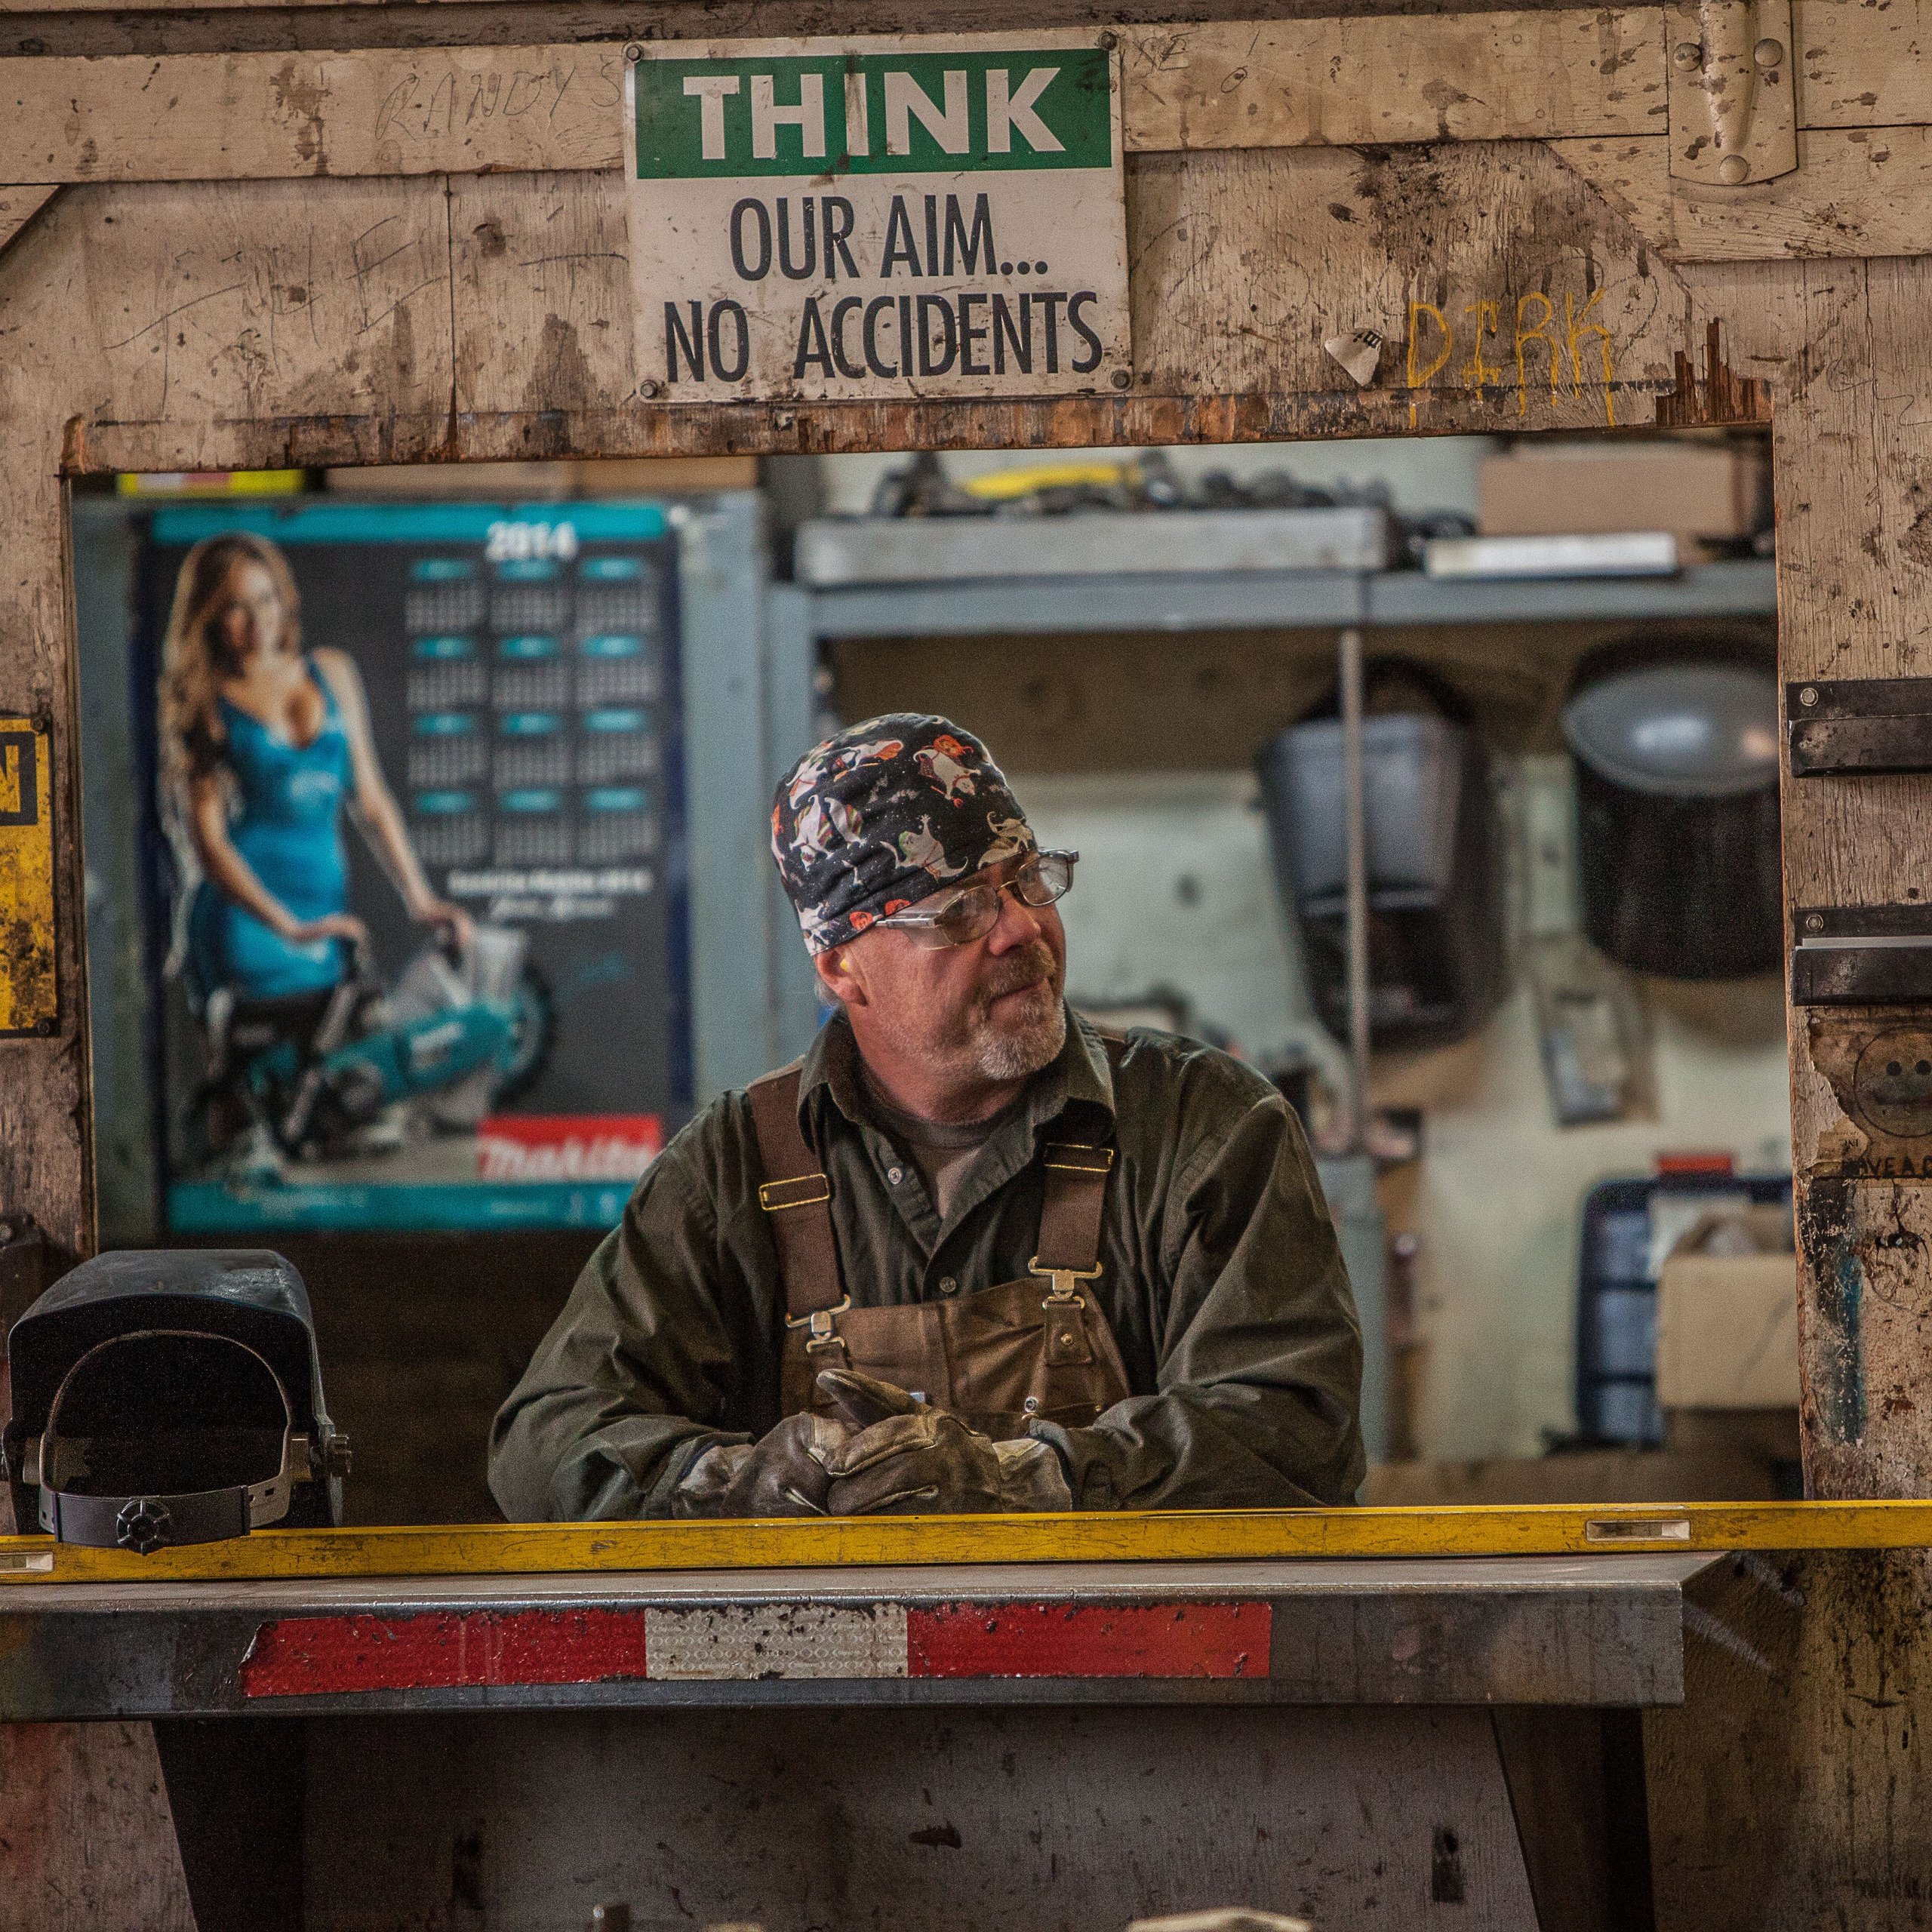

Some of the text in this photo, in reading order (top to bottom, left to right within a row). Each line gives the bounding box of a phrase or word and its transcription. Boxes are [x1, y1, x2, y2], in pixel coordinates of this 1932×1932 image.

[682, 67, 1066, 160] THINK
[730, 195, 860, 281] OUR
[664, 299, 750, 383] NO
[793, 290, 1103, 379] ACCIDENTS
[1407, 288, 1616, 428] DIRK
